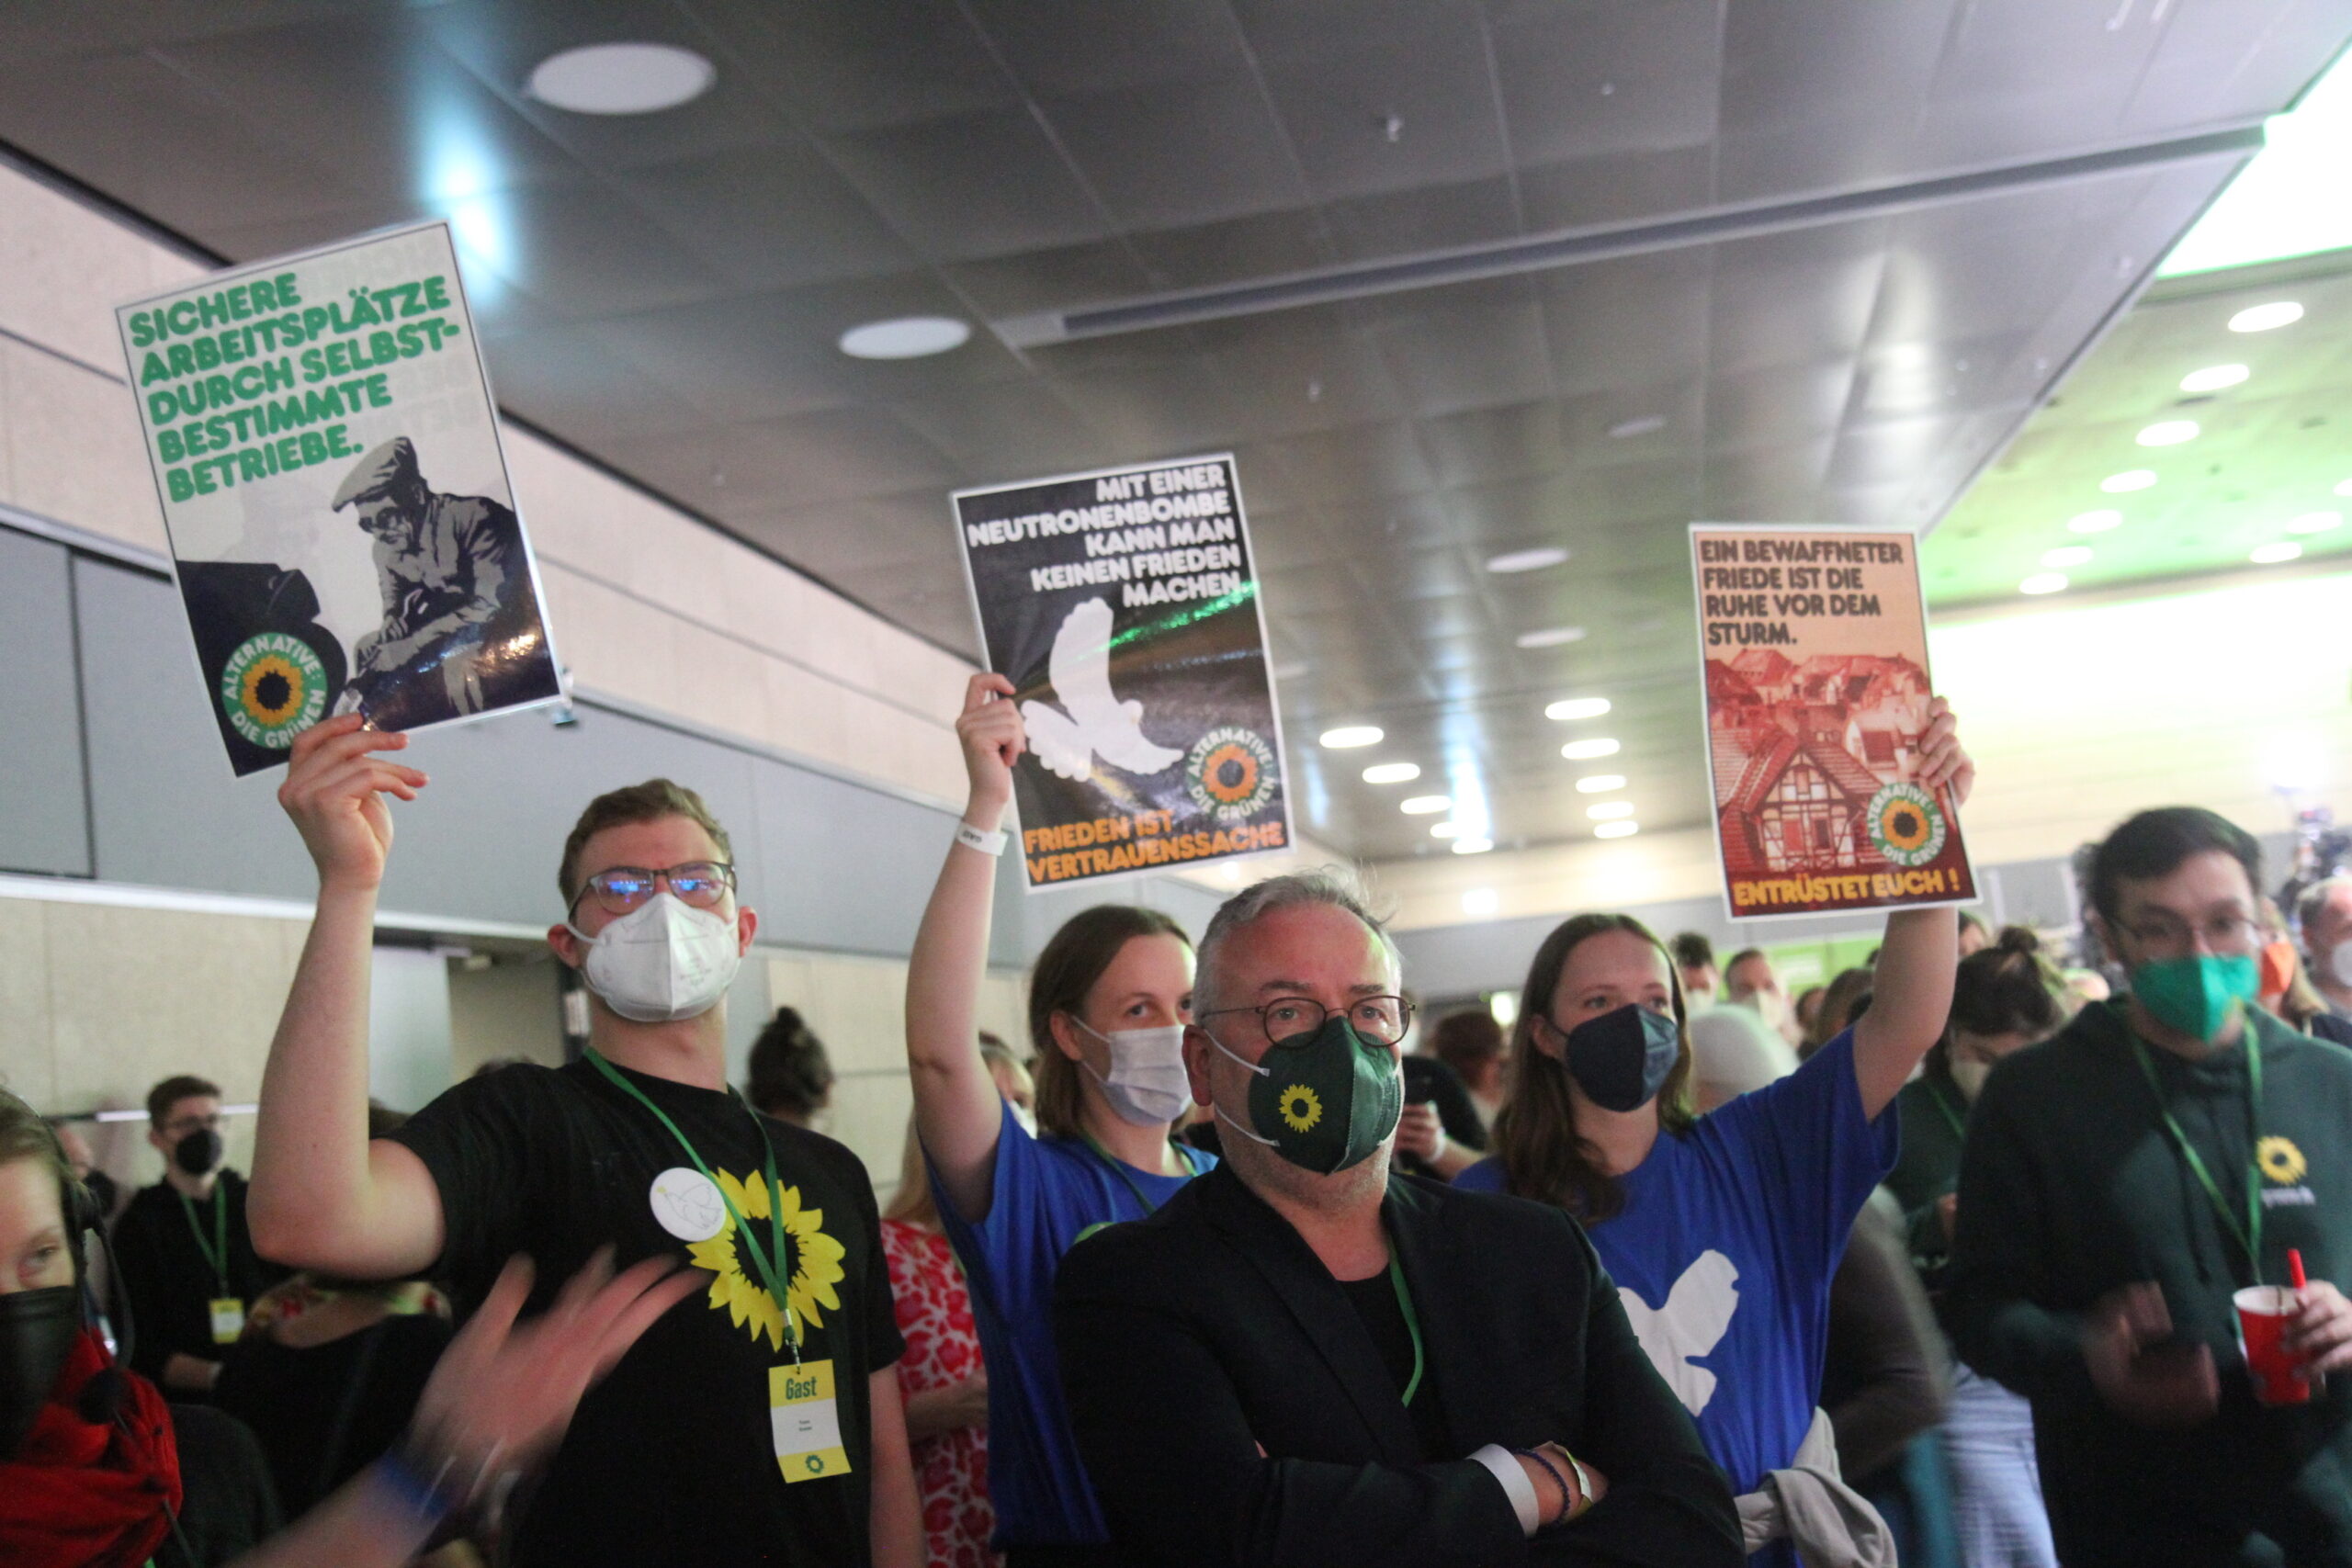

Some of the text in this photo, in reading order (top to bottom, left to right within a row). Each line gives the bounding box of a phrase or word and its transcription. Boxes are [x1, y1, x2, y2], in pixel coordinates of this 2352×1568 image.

[130, 273, 301, 347] SICHERE
[141, 276, 451, 388] ARBEITSPLÄTZE
[148, 317, 460, 426] DURCH SELBST-
[157, 373, 392, 465] BESTIMMTE
[166, 423, 363, 502] BETRIEBE.
[1096, 463, 1227, 502] MIT EINER
[967, 491, 1231, 547] NEUTRONENBOMBE
[1085, 516, 1236, 558] KANN MAN
[1031, 544, 1241, 592] KEINEN FRIEDEN
[1701, 540, 1904, 564] EIN BEWAFFNETER
[1703, 568, 1863, 590] FRIEDE IST DIE
[1705, 594, 1881, 617] RUHE VOR DEM
[1708, 622, 1797, 646] STURM.
[232, 710, 261, 742] DIE
[1190, 776, 1275, 820] DIE GRÜNEN
[1024, 809, 1175, 854] FRIEDEN IST
[1028, 821, 1284, 883] VERTRAUENSSACHE
[1883, 814, 1946, 865] DIE GRÜNEN
[1733, 874, 1871, 906] ENTRÜSTET
[1871, 869, 1945, 897] EUCH
[786, 1376, 817, 1400] Gast
